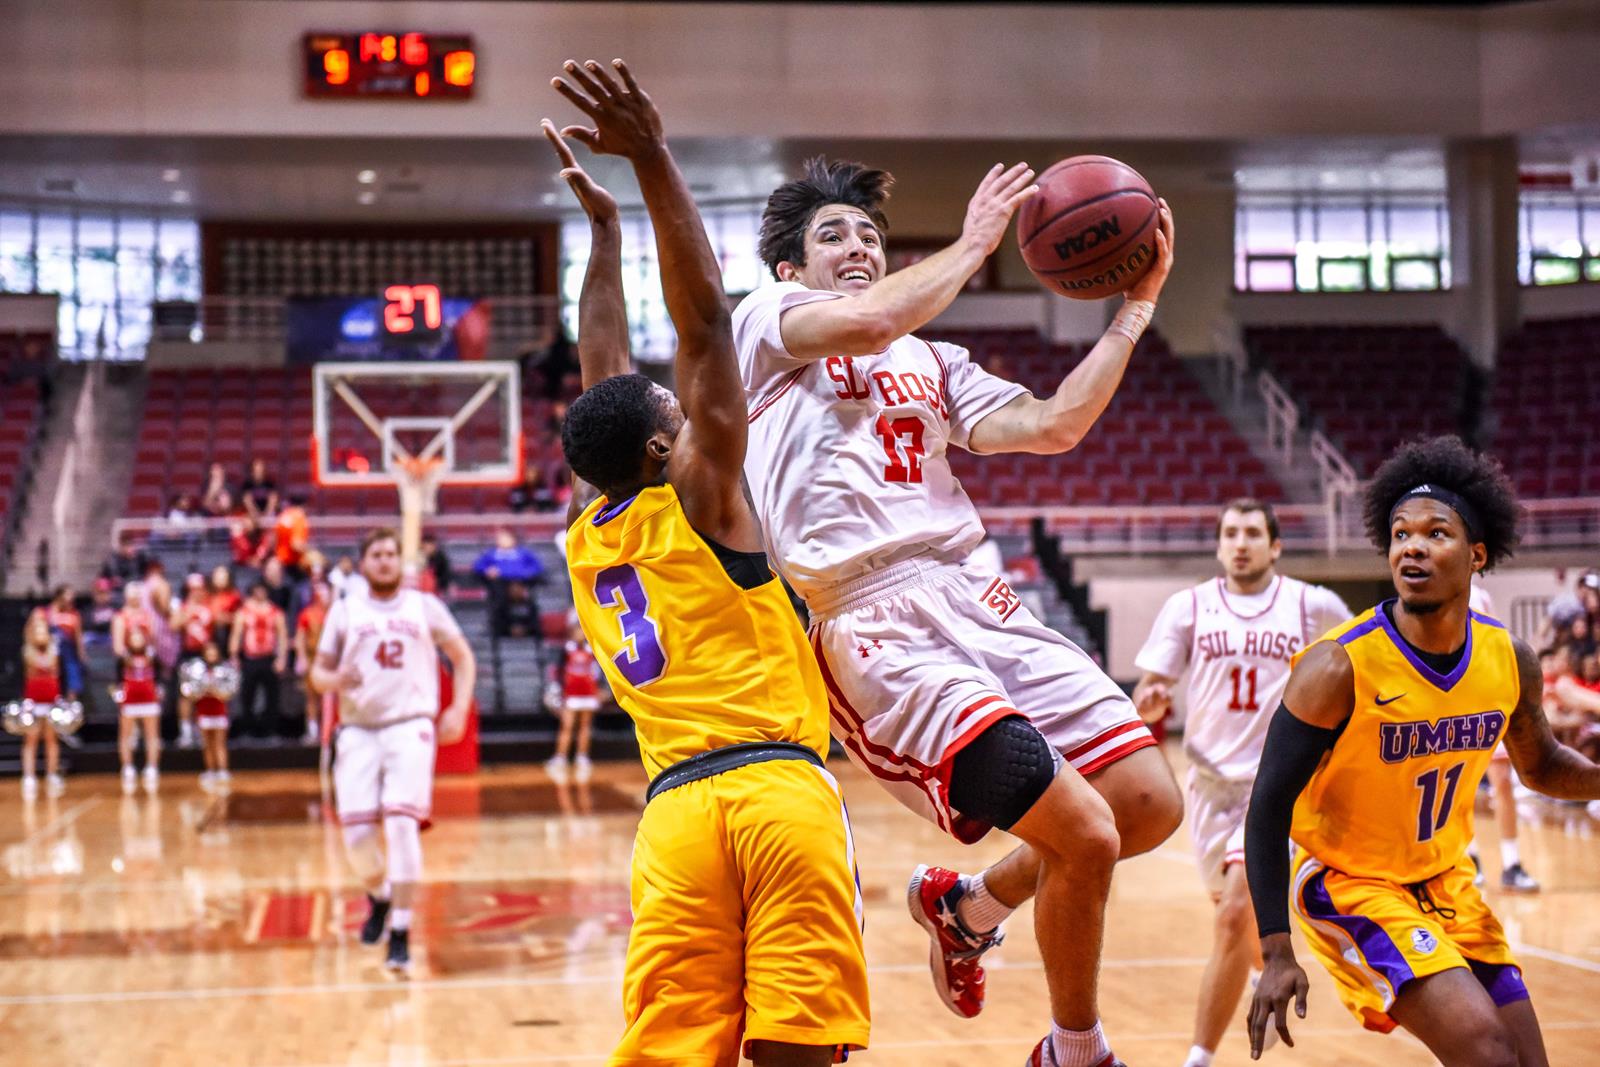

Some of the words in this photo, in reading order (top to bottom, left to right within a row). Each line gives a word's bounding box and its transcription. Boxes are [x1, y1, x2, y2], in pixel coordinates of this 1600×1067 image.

[1054, 214, 1121, 261] NCAA
[1060, 243, 1151, 290] Wilson
[384, 285, 441, 333] 27
[875, 413, 925, 483] 12
[593, 562, 670, 689] 3
[1198, 629, 1237, 663] SUL
[1244, 630, 1300, 663] ROSS
[374, 639, 404, 670] 42
[1228, 664, 1259, 713] 11
[1380, 709, 1506, 764] UMHB
[1414, 761, 1466, 843] 11
